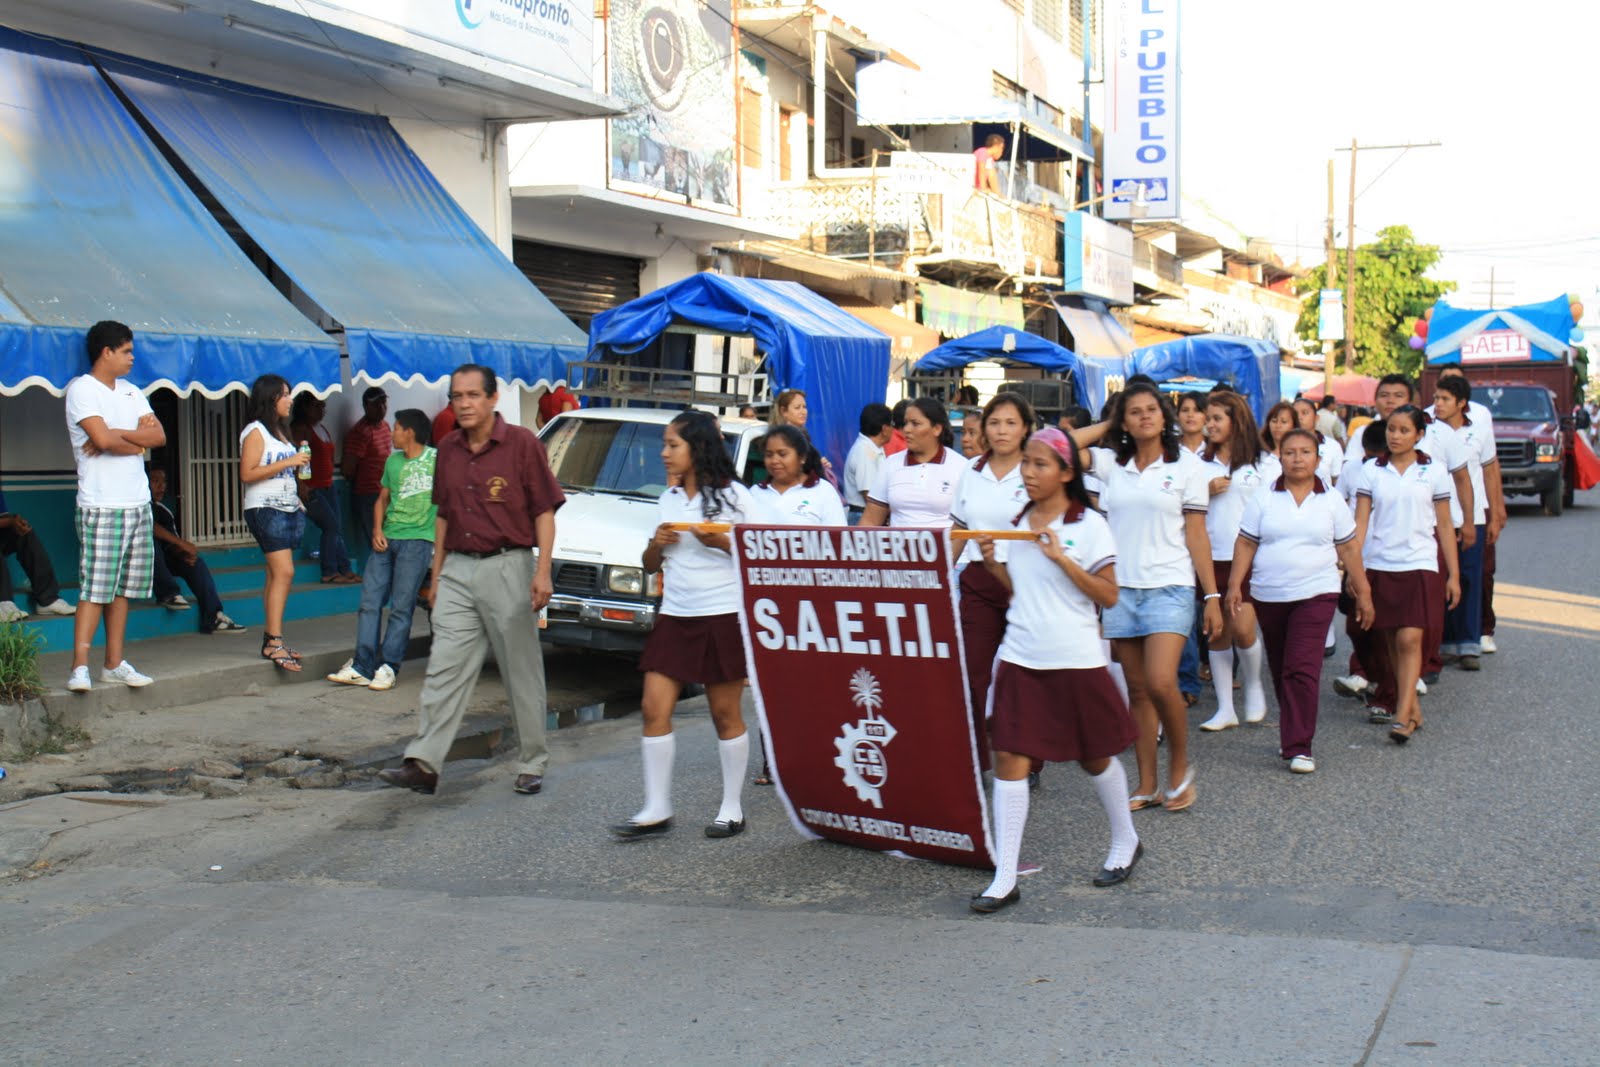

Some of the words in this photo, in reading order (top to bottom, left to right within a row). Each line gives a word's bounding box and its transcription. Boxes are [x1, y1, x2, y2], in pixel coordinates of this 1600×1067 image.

[500, 0, 569, 26] apronto
[1136, 29, 1167, 164] PUEBLO
[742, 530, 838, 561] SISTEMA
[840, 530, 938, 563] ABIERTO
[753, 598, 950, 658] S.A.E.T.I.
